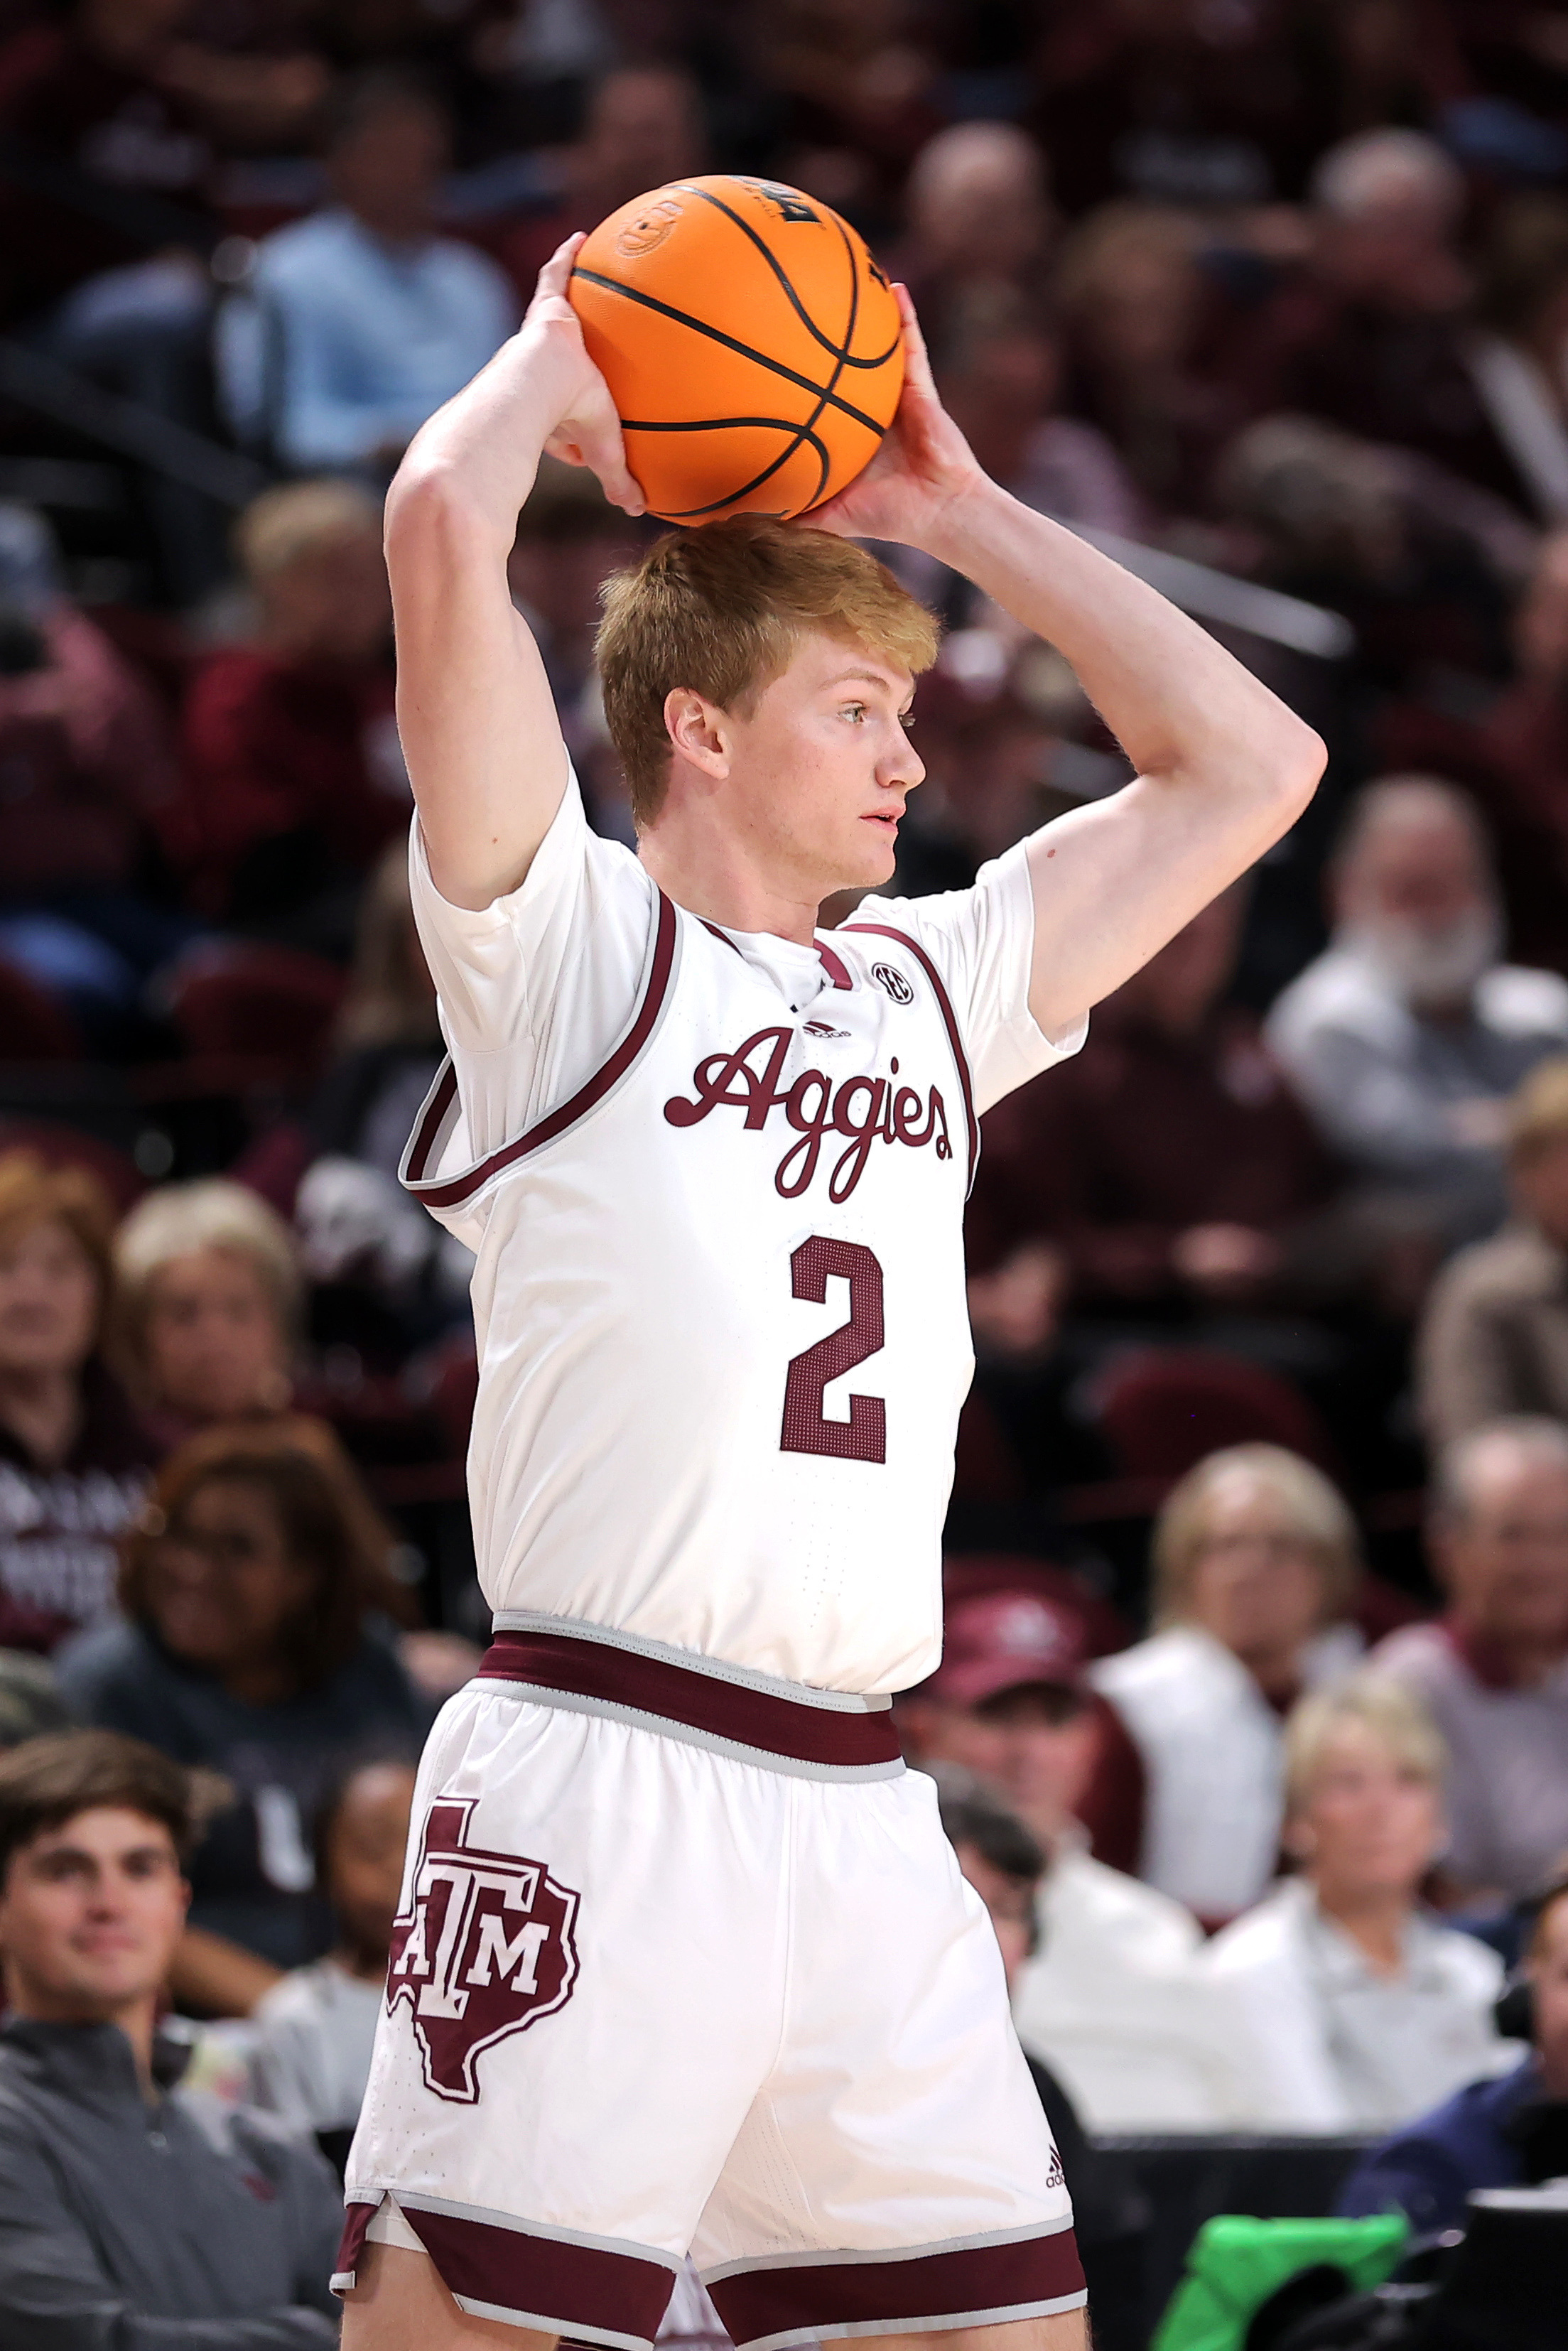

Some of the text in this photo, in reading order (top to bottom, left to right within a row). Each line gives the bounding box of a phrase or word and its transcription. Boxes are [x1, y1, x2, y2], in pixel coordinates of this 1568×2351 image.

[875, 966, 909, 1000] SEC
[664, 1027, 953, 1204] Aggies
[779, 1235, 886, 1464] 2
